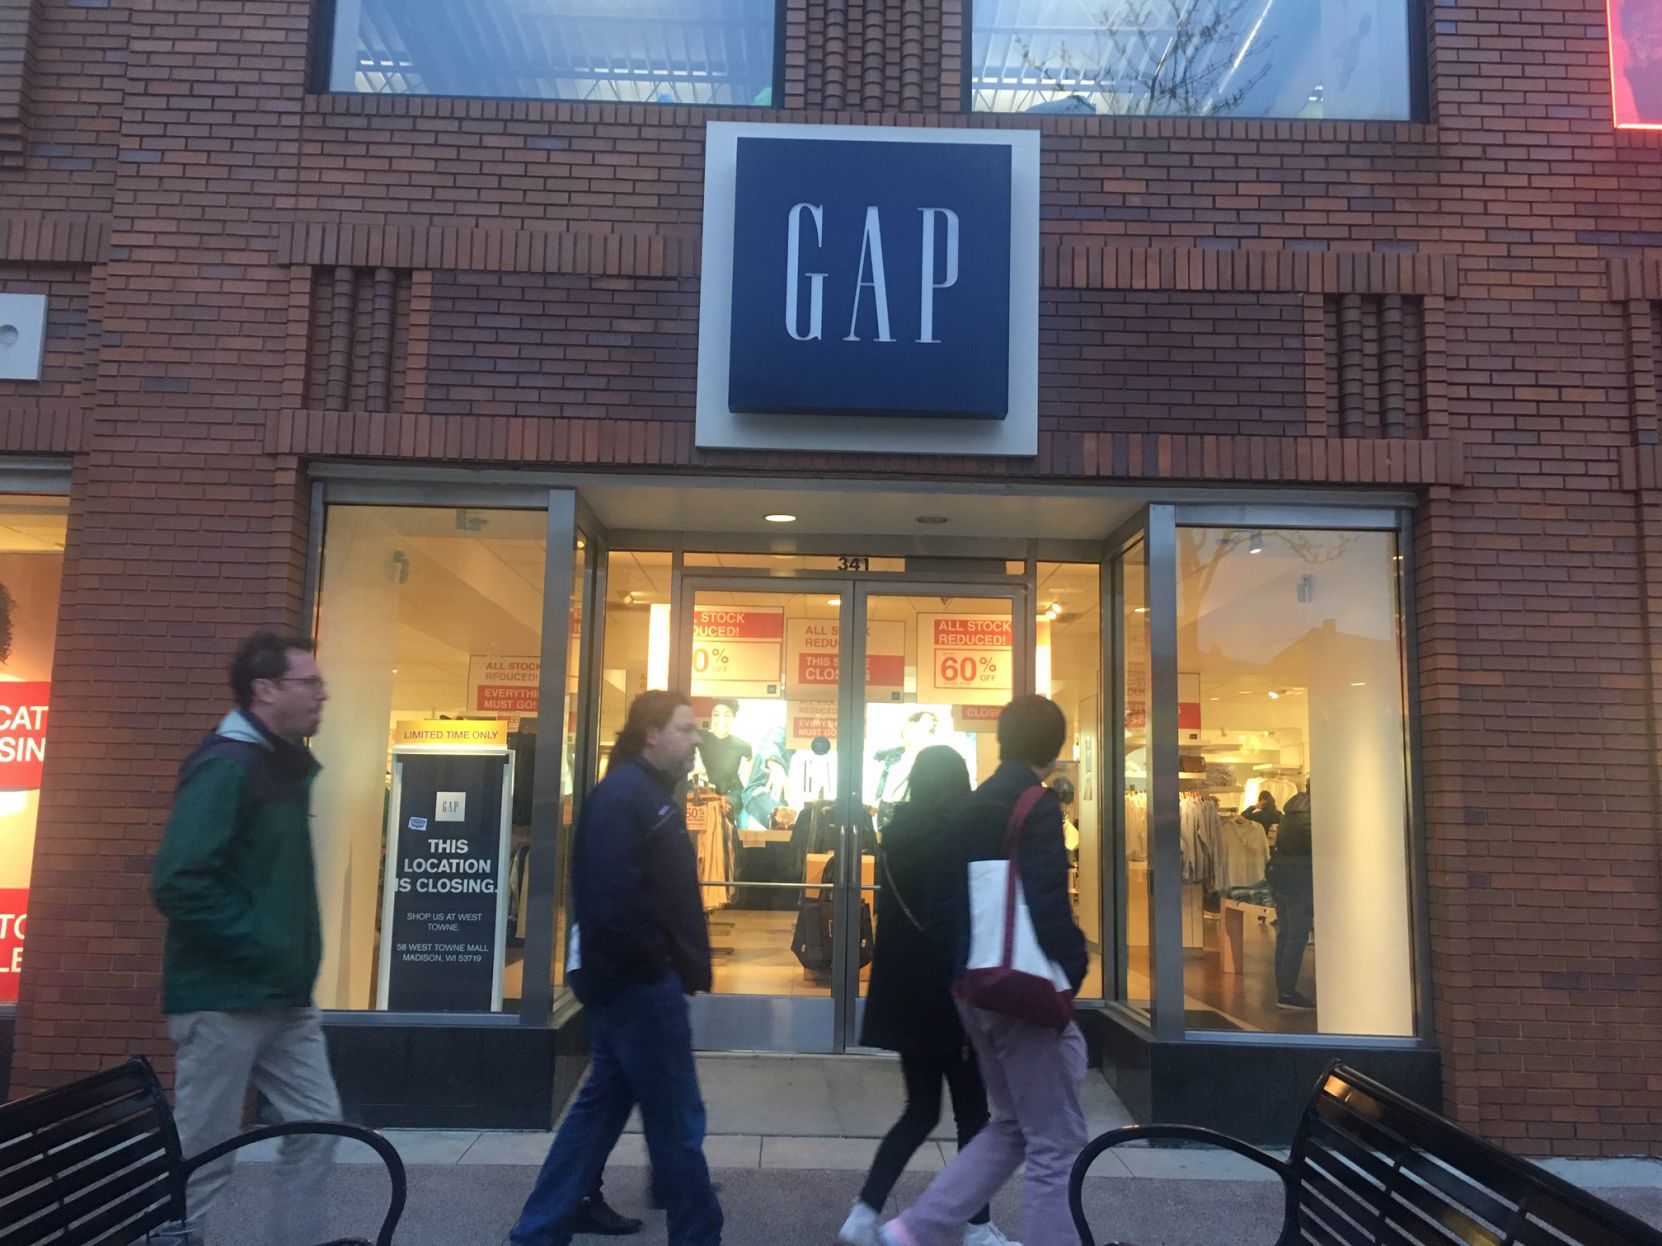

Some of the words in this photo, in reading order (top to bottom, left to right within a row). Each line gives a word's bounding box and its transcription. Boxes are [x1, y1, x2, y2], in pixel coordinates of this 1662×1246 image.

[785, 202, 960, 343] GAP
[837, 556, 869, 571] 341
[701, 612, 745, 624] STOCK
[805, 625, 828, 635] ALL
[939, 620, 964, 631] ALL
[967, 621, 1011, 632] STOCK
[939, 634, 1006, 645] REDUCED!
[486, 662, 506, 670] ALL
[805, 656, 831, 666] THIS
[980, 674, 996, 682] OFF
[484, 700, 512, 709] MUST
[516, 700, 537, 710] GO!
[404, 731, 443, 739] LIMITED
[446, 731, 470, 739] TIME
[472, 731, 498, 740] ONLY
[442, 801, 459, 812] GAP
[428, 839, 469, 853] THIS
[404, 858, 491, 873] LOCATION
[416, 878, 497, 893] CLOSING.
[407, 913, 431, 921] SHOP
[433, 913, 444, 921] US
[446, 913, 455, 921] AT
[458, 913, 482, 921] WEST
[435, 944, 465, 952] TOWNE
[467, 944, 489, 952] MALL
[446, 954, 456, 962] WI
[459, 954, 482, 962] 53719
